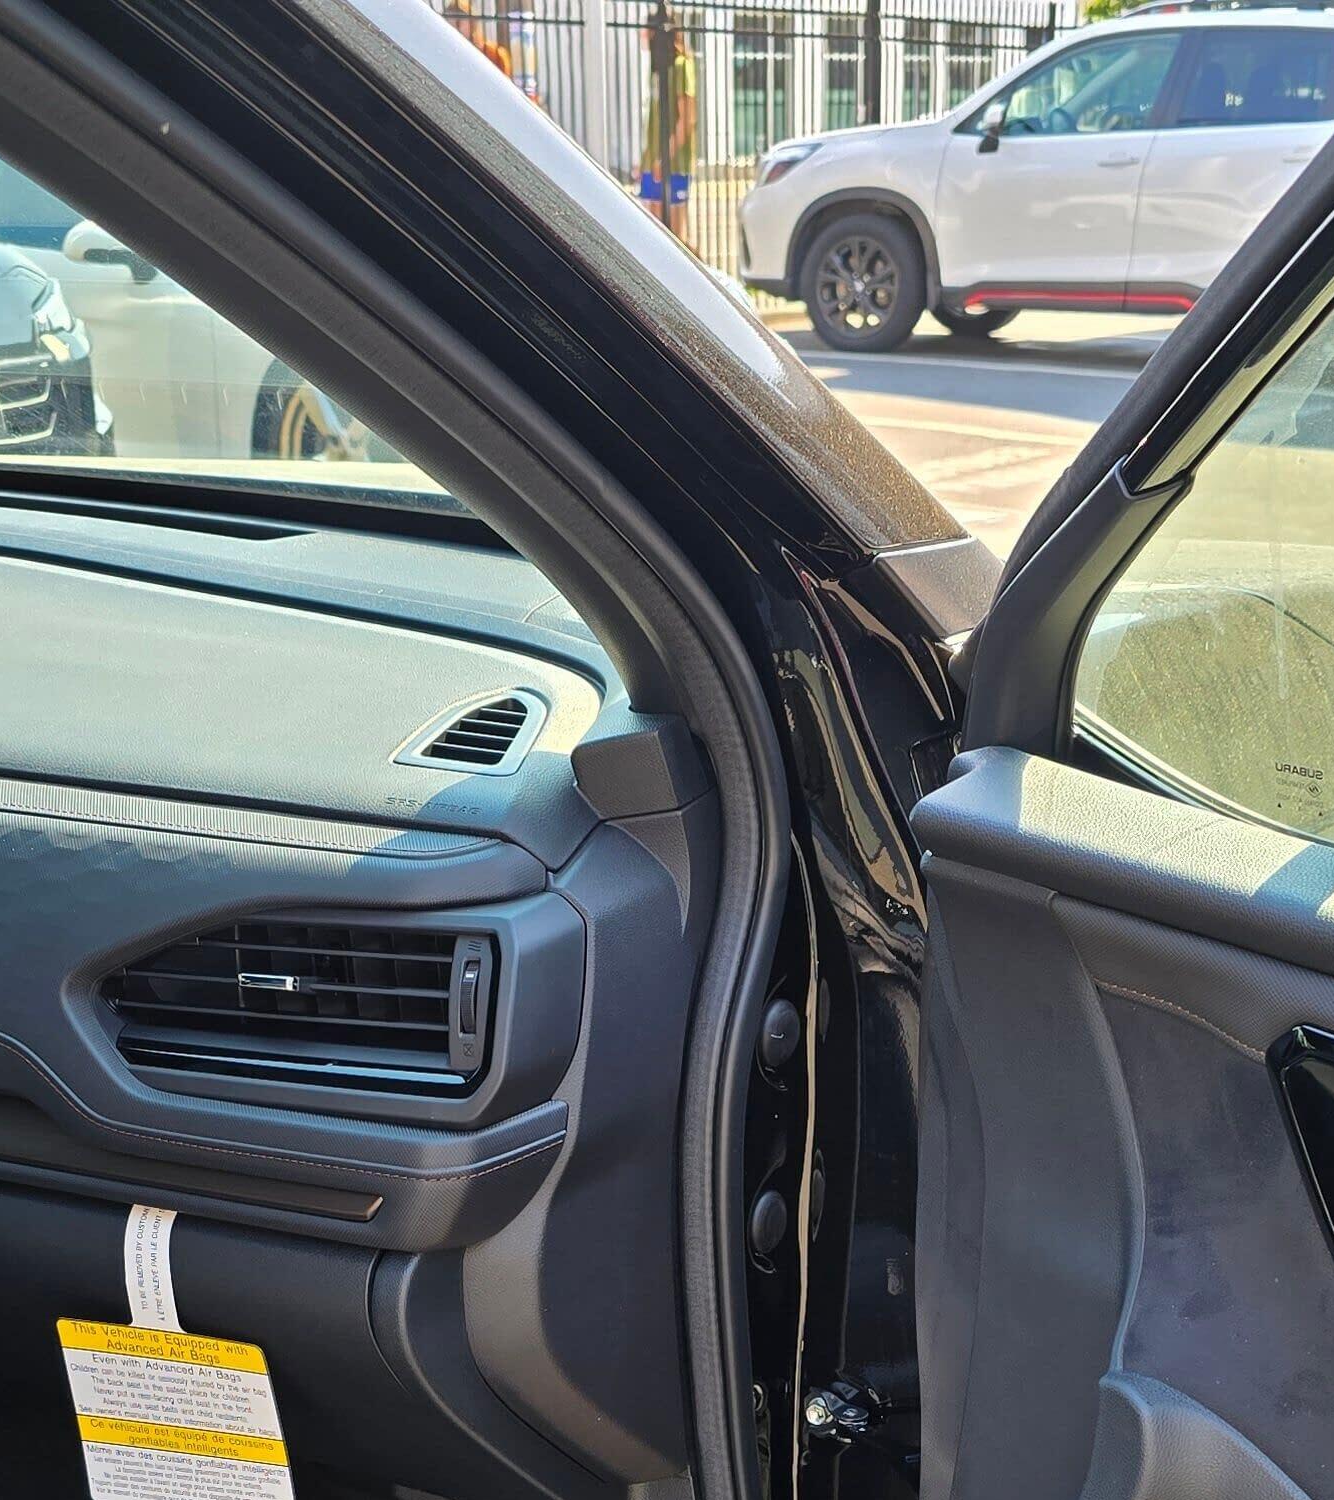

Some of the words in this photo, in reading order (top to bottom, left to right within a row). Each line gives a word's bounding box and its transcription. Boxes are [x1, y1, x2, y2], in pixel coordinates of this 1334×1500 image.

[70, 1322, 97, 1335] This
[101, 1325, 145, 1341] Vehicle
[149, 1333, 159, 1344] is
[165, 1334, 220, 1351] Equipped
[224, 1345, 249, 1356] with
[106, 1339, 164, 1356] Advanced
[169, 1348, 185, 1359] Air
[190, 1352, 220, 1365] Bags
[70, 1363, 99, 1374] Children
[91, 1353, 117, 1365] Even
[122, 1358, 141, 1368] with
[145, 1361, 194, 1375] Advanced
[198, 1367, 212, 1377] Air
[216, 1370, 242, 1383] Bags
[90, 1418, 105, 1428] Ce
[154, 1428, 170, 1436] est
[211, 1434, 225, 1444] de
[228, 1437, 274, 1451] coussins
[128, 1436, 180, 1449] gonflables
[184, 1442, 239, 1457] intelligents
[115, 1449, 135, 1458] avec
[138, 1451, 154, 1460] des
